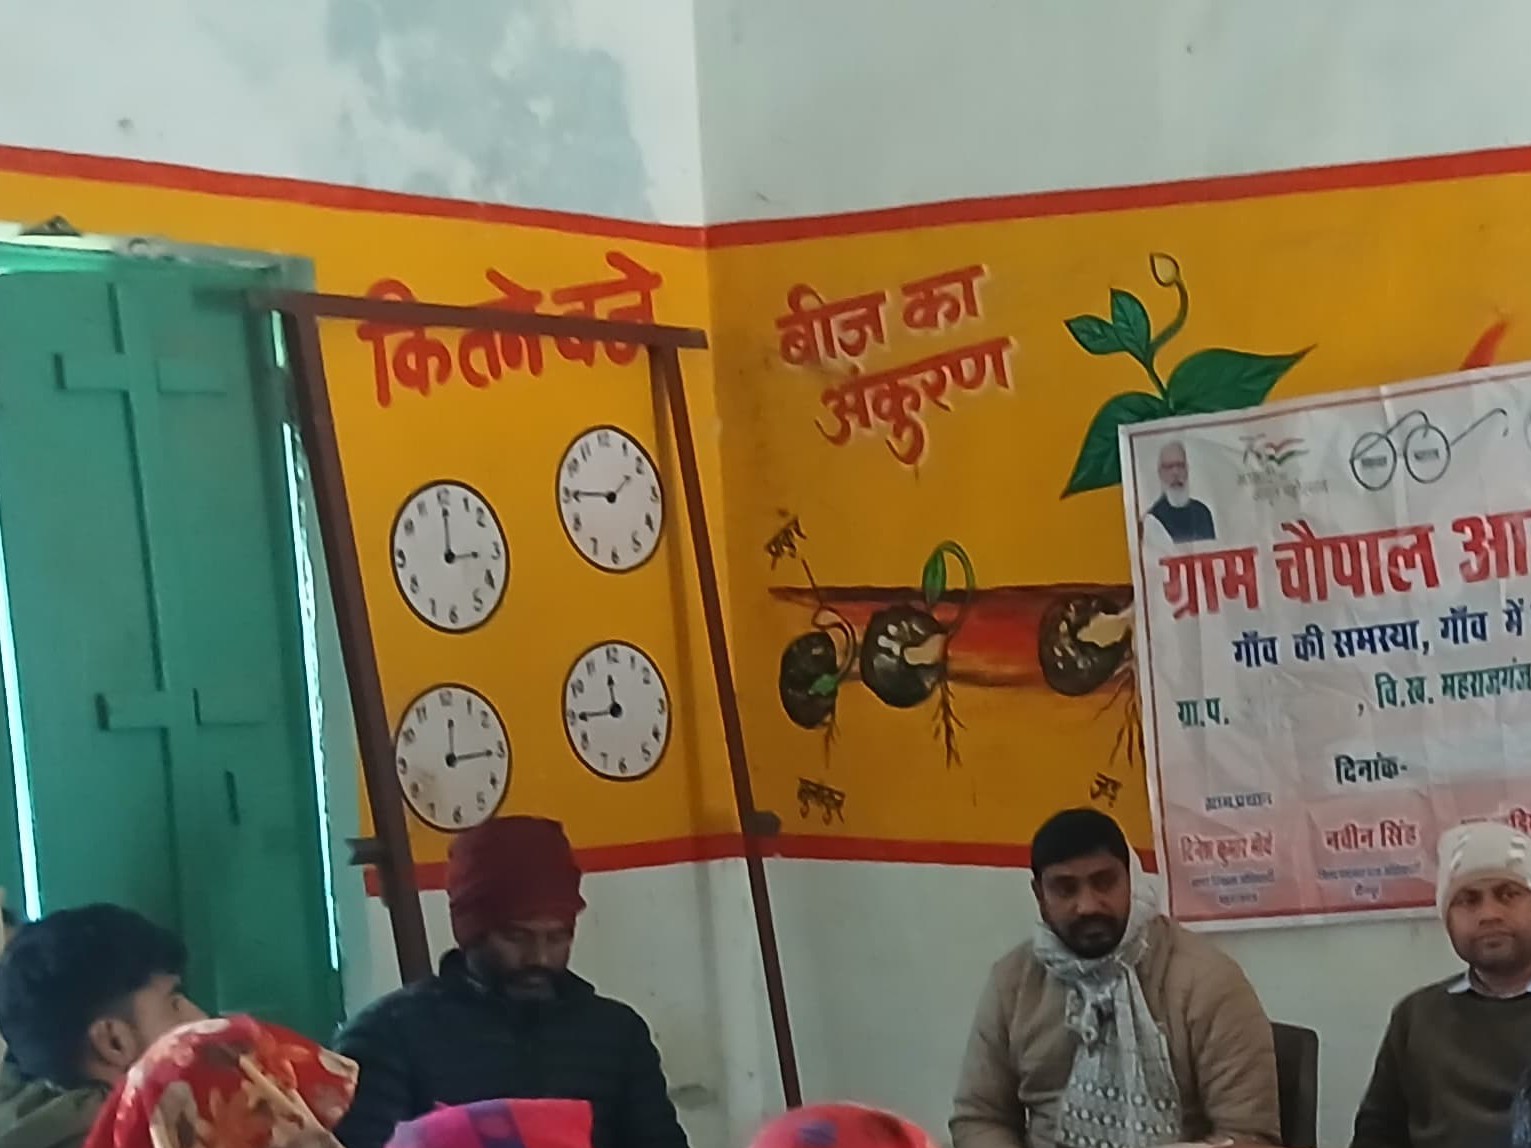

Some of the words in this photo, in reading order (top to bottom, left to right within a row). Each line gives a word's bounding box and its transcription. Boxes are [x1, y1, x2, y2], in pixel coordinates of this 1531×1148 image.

[774, 282, 887, 367] बीज
[900, 263, 987, 329] का
[814, 335, 1014, 466] अंकुरण
[1159, 547, 1260, 620] ग्राम
[1273, 519, 1441, 604] चौपाल
[1292, 623, 1326, 662] की
[1502, 597, 1525, 637] में
[1324, 822, 1374, 851] नवीन
[1379, 819, 1418, 848] सिंह
